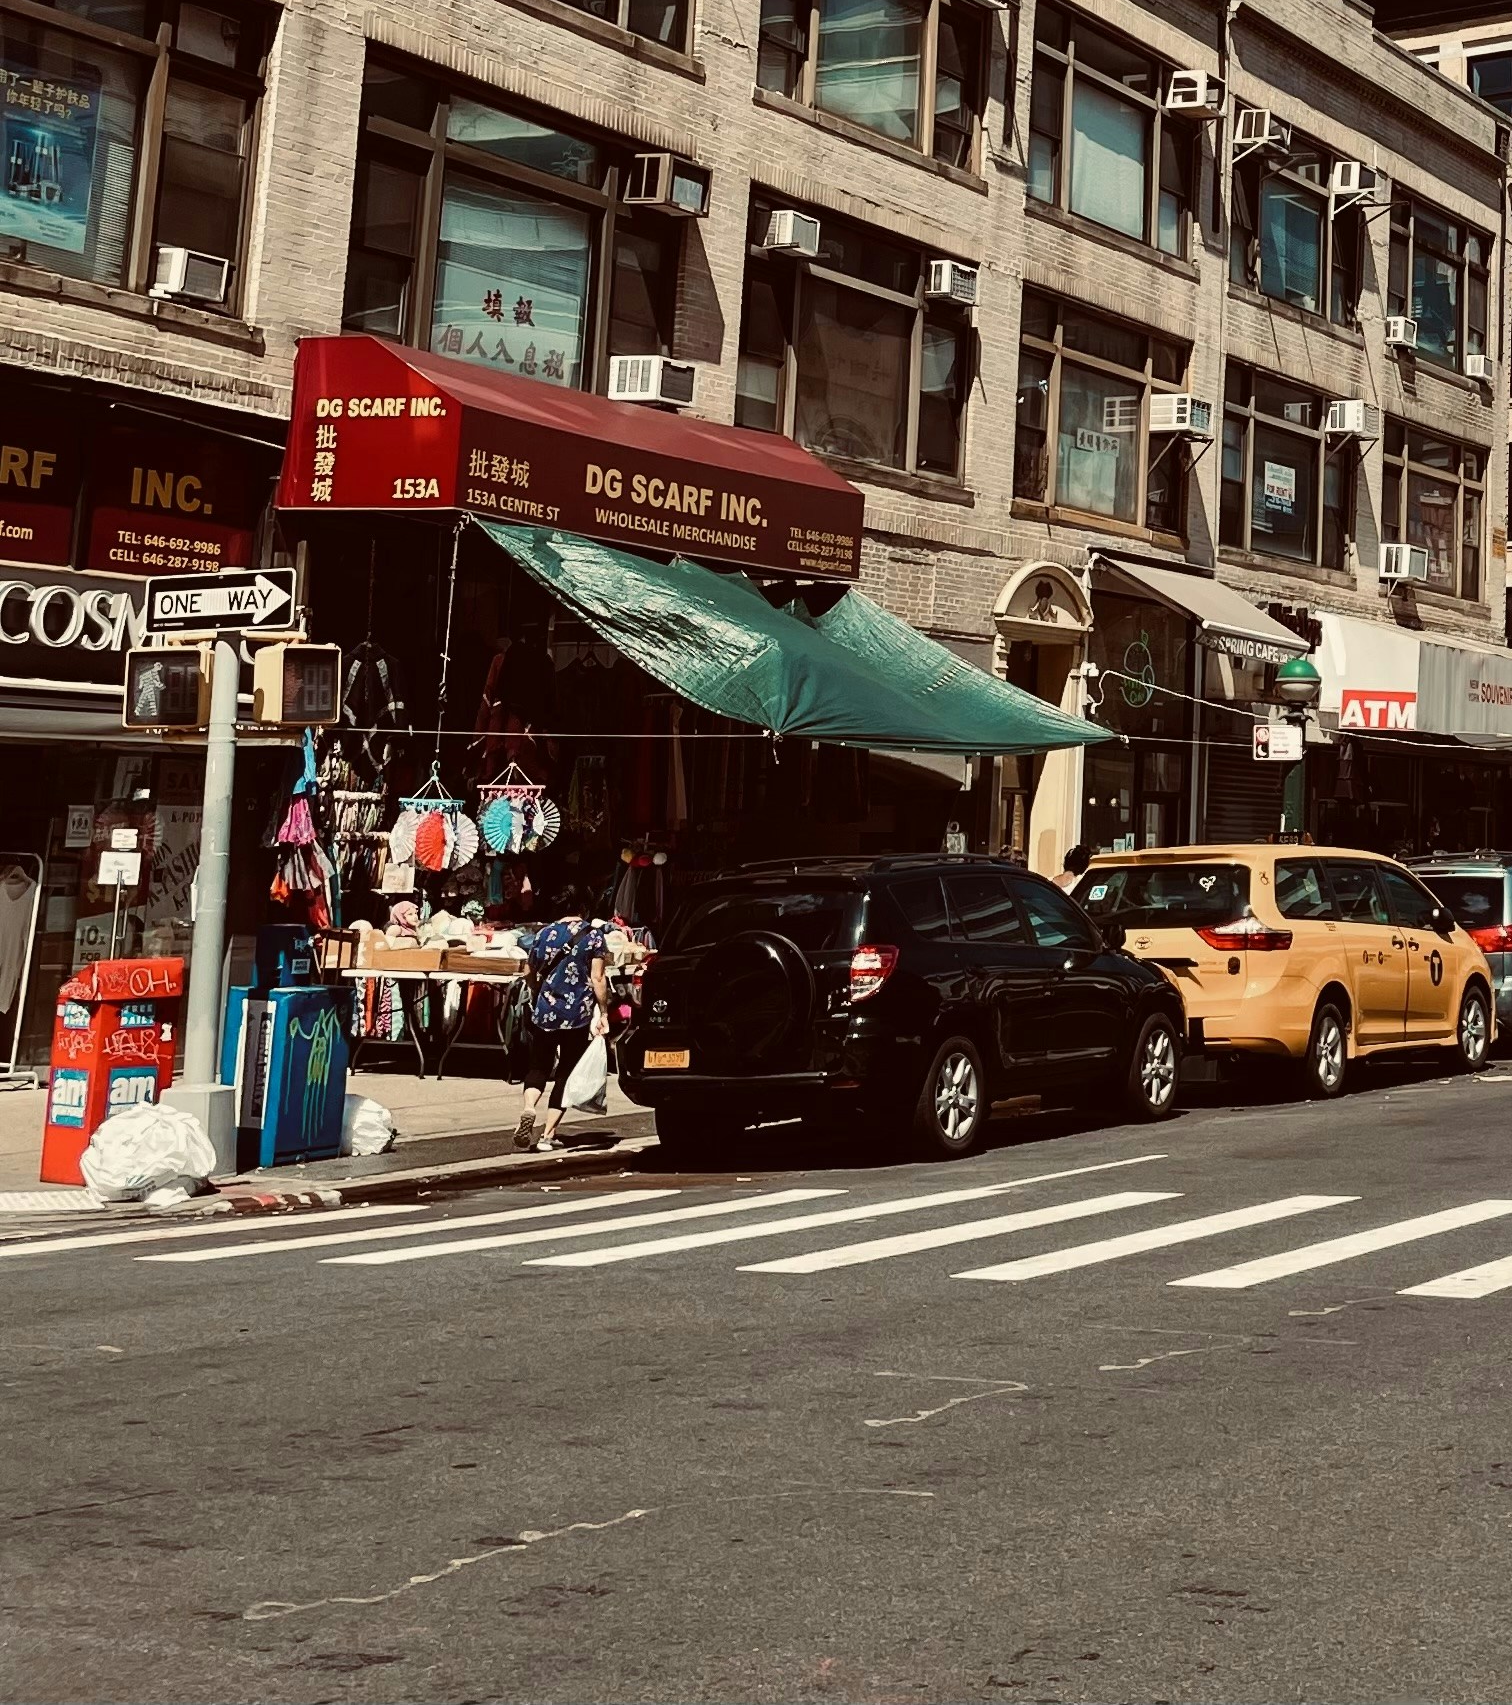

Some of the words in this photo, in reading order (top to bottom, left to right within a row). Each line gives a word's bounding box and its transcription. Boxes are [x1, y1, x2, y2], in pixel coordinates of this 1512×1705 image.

[316, 398, 343, 418] DG
[347, 397, 406, 417] SCARF
[410, 397, 447, 417] INC.
[310, 424, 338, 502] 批發城
[468, 448, 530, 489] 批發城
[130, 467, 214, 515] INC.
[391, 478, 440, 499] 153A
[585, 463, 623, 499] DG
[630, 473, 713, 516] SCARF
[720, 492, 768, 528] INC.
[466, 488, 497, 509] 153A
[499, 495, 544, 519] CENTRE
[546, 505, 560, 522] ST
[117, 530, 142, 545] TEL:
[144, 534, 221, 556] 646-692-9986
[595, 507, 670, 537] WHOLESALE
[672, 523, 757, 551] MERCHANDISE
[109, 548, 140, 564] CELL:
[142, 552, 220, 573] 646-287-9198
[160, 593, 203, 615] ONE
[227, 588, 273, 612] WAY
[1218, 636, 1254, 657] SPRING
[1255, 642, 1279, 662] CAFE
[1341, 699, 1416, 729] ATM
